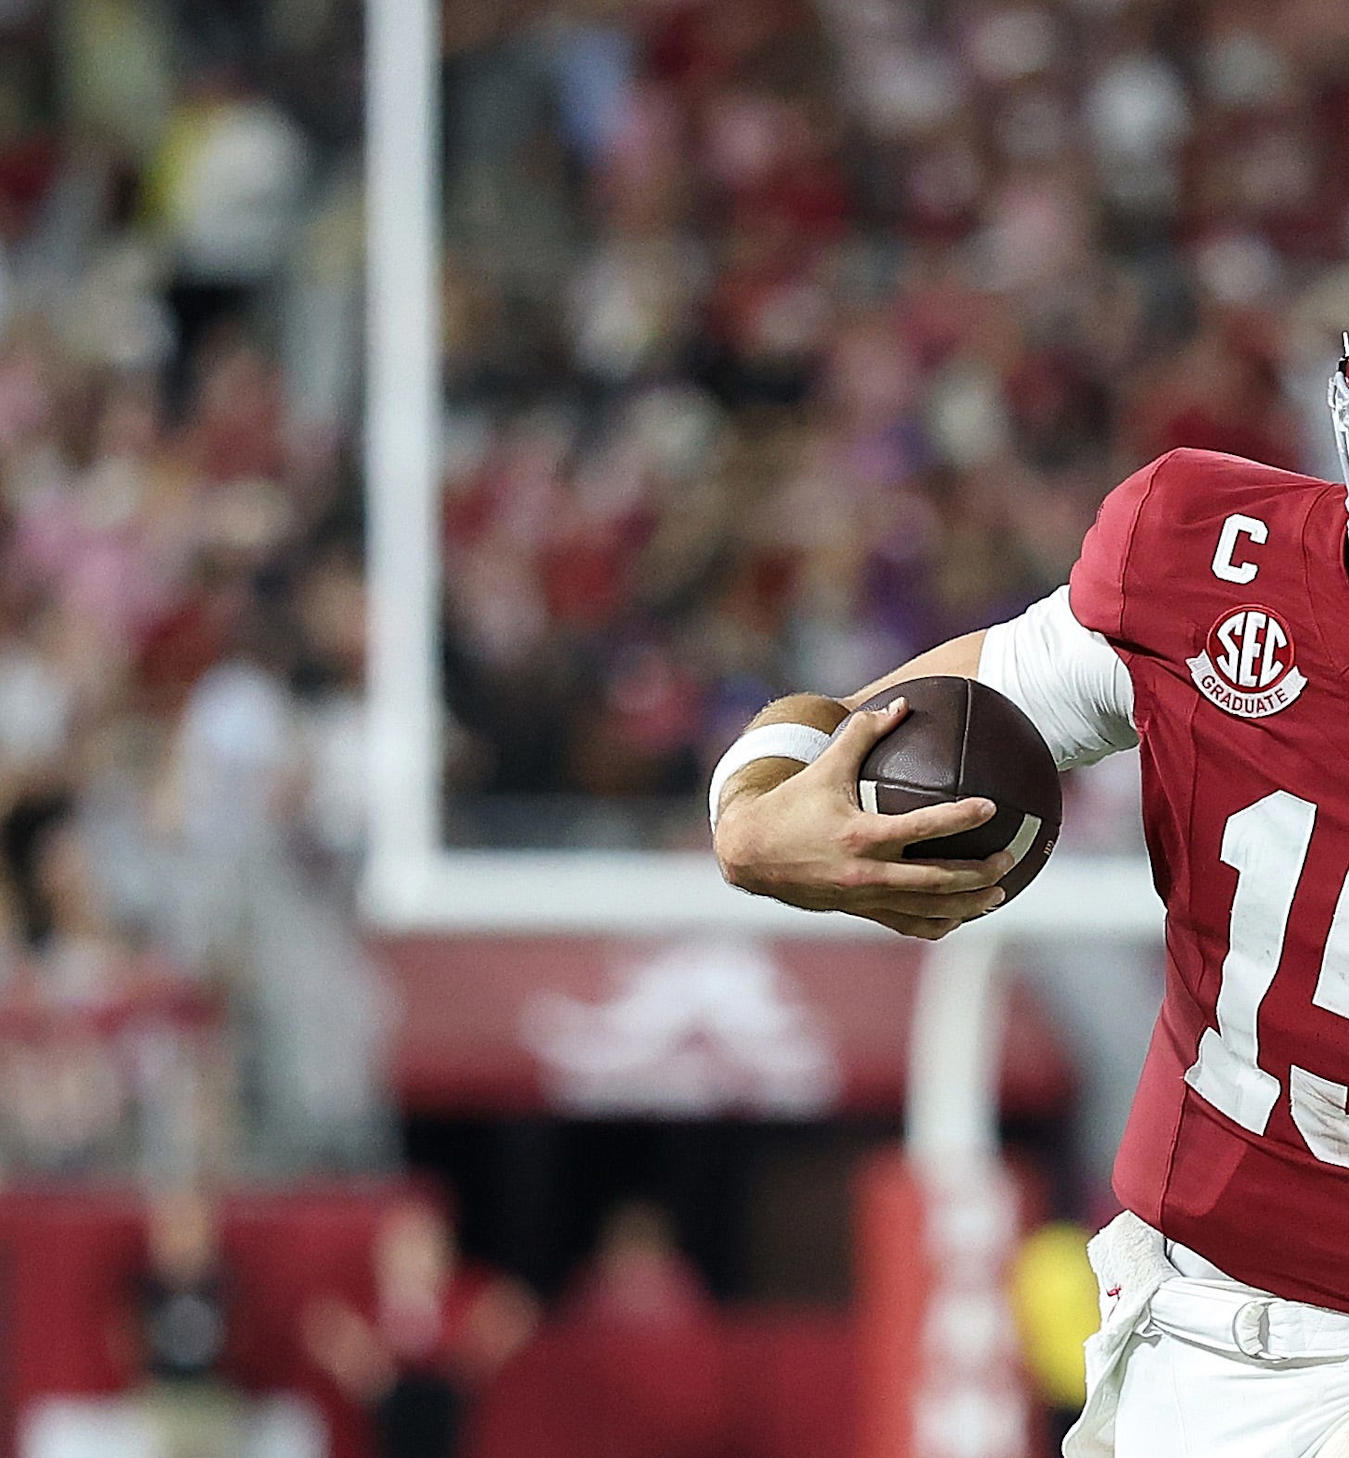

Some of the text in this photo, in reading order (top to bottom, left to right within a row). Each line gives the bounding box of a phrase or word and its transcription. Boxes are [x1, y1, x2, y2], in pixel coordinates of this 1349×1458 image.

[1211, 512, 1270, 585] C
[1216, 610, 1289, 688] SEC
[1200, 674, 1290, 714] GRADUATE
